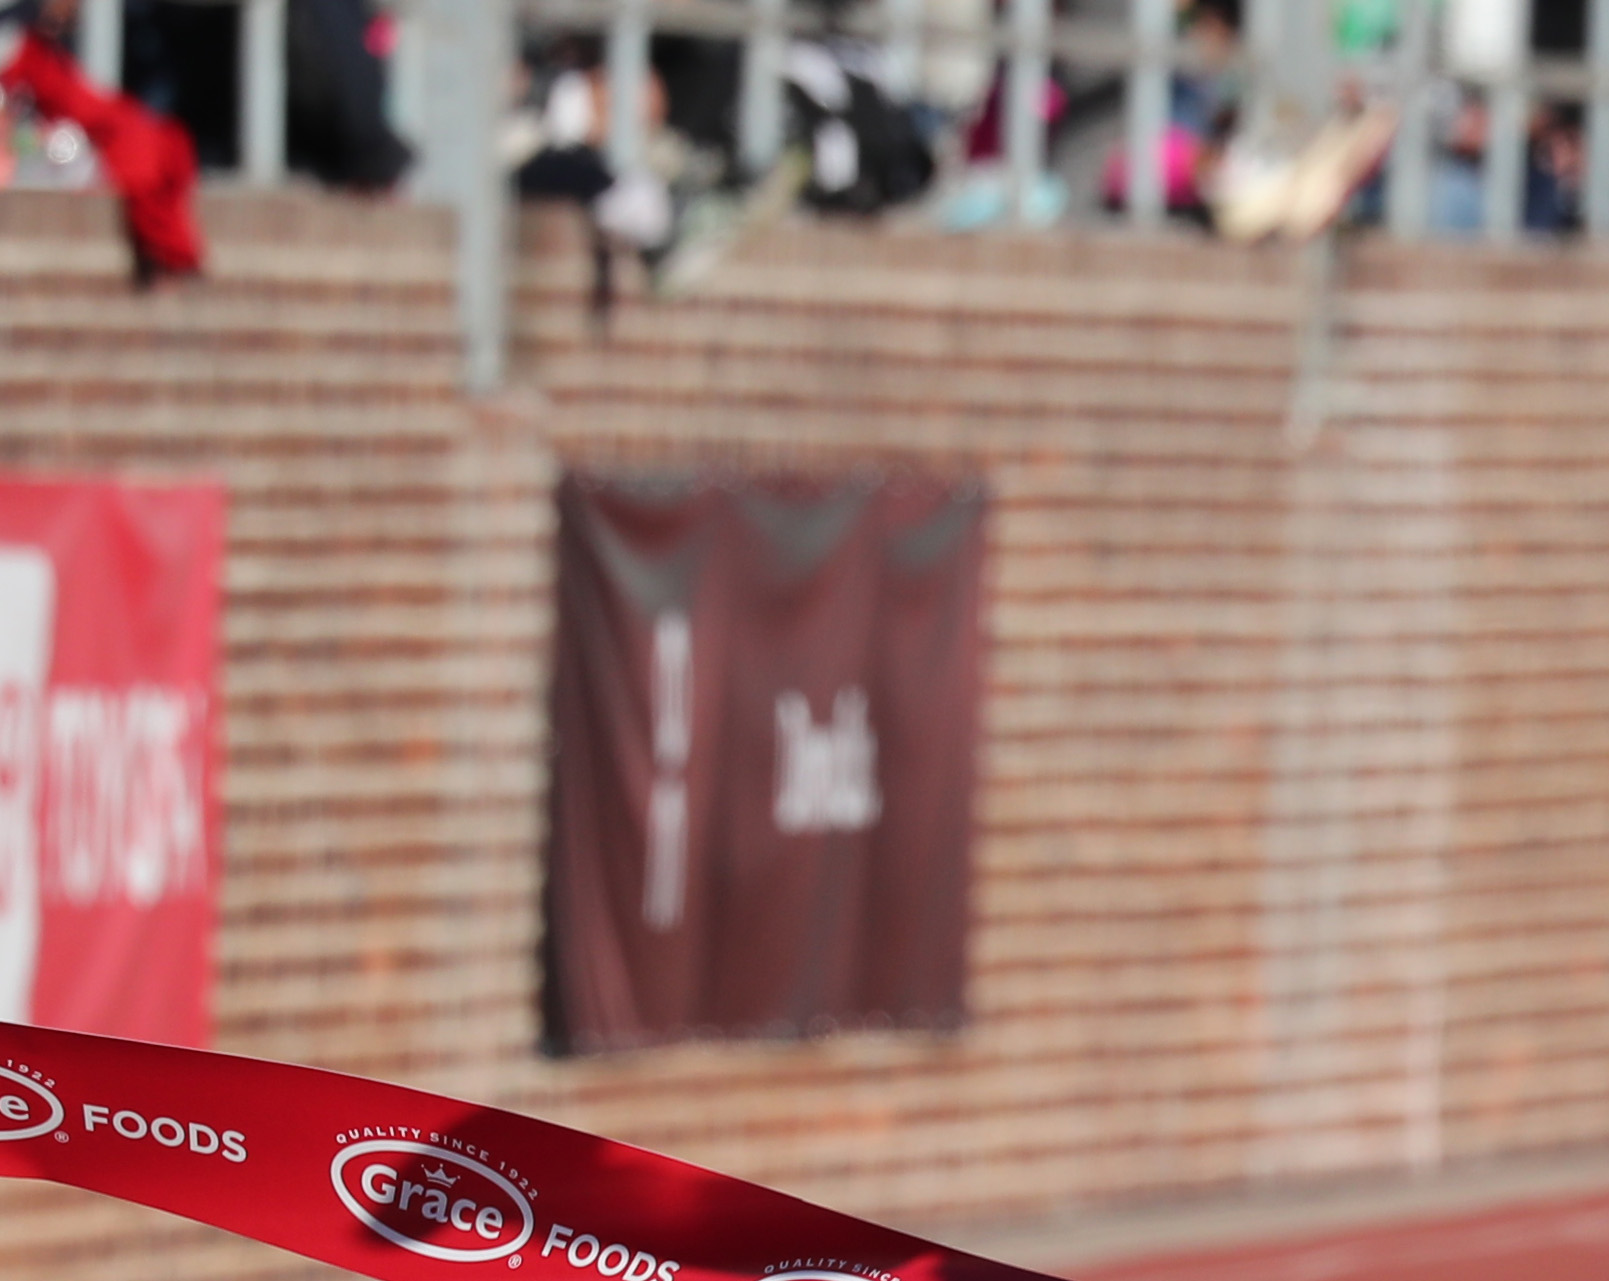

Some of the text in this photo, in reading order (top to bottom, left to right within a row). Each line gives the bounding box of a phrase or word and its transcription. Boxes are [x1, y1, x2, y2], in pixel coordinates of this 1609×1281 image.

[6, 1058, 56, 1088] 1922
[82, 1103, 248, 1163] FOODS
[335, 1125, 540, 1201] QUALITY SINCE 1922
[360, 1163, 504, 1240] Grace
[763, 1257, 848, 1274] QUALITY
